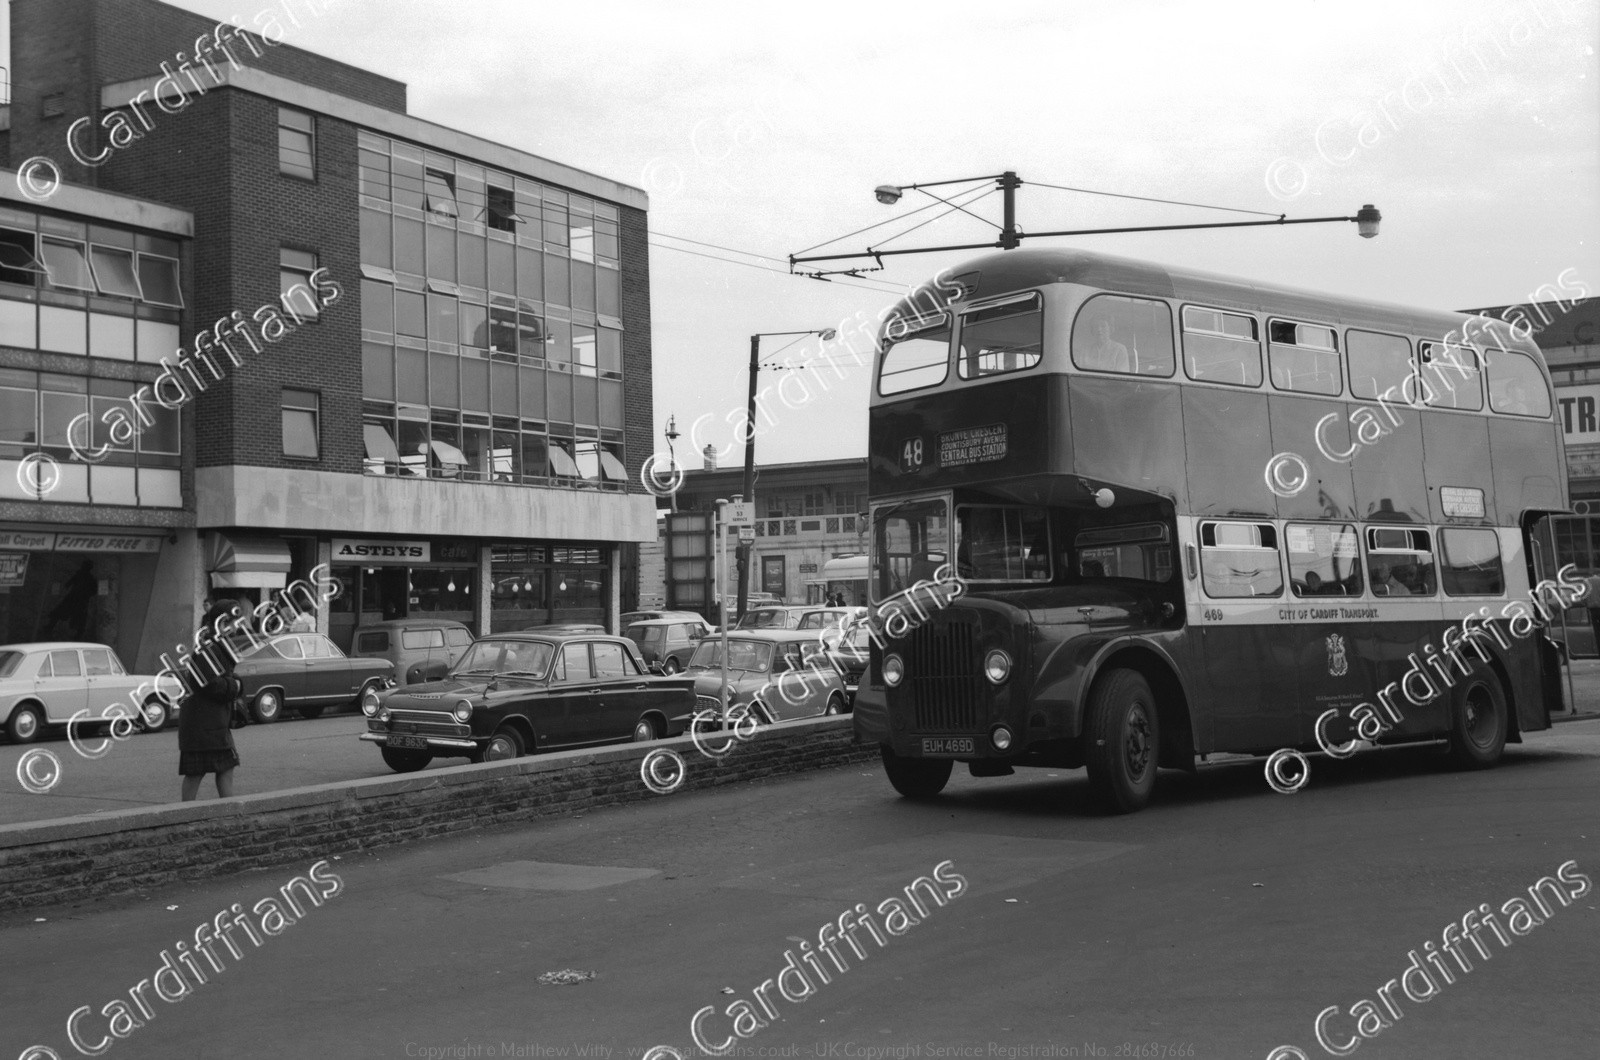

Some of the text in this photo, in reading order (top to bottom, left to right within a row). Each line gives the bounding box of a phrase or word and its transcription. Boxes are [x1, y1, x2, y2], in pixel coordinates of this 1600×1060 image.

[1559, 396, 1600, 434] TR
[983, 434, 1006, 444] AVENUE
[904, 439, 922, 466] 48
[941, 443, 1006, 462] CENTRAL BUS STATION
[13, 534, 46, 547] Carpet
[58, 537, 141, 549] FITTED FREE
[339, 544, 422, 556] ASTEYS
[1204, 608, 1223, 621] 469
[1279, 609, 1295, 620] CITY
[1298, 609, 1308, 619] OF
[1310, 608, 1339, 619] CARDIFF
[923, 740, 973, 752] EUH 469D
